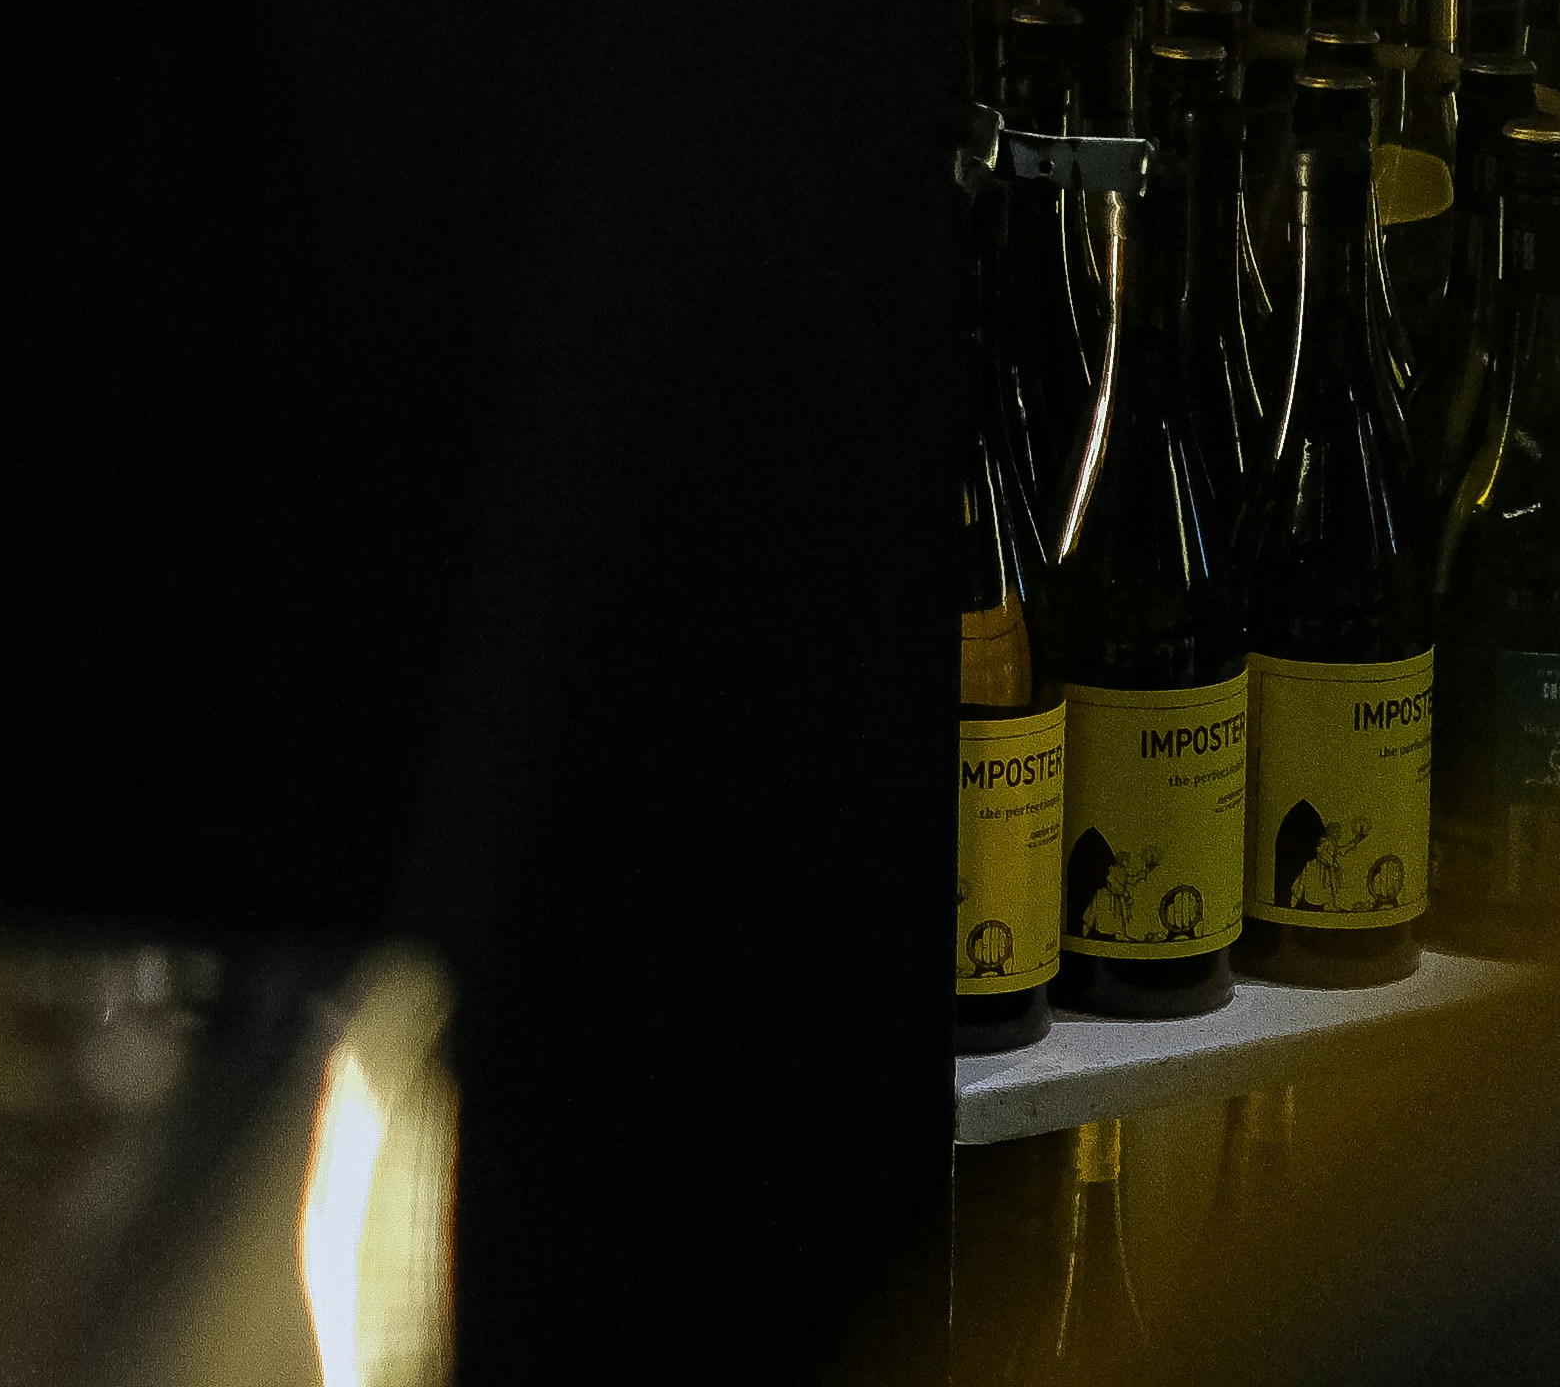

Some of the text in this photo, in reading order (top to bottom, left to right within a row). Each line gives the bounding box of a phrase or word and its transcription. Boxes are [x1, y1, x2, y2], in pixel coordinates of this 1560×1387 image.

[1141, 711, 1247, 759] IMPOSTER
[1168, 774, 1190, 788] the
[980, 807, 1001, 820] the
